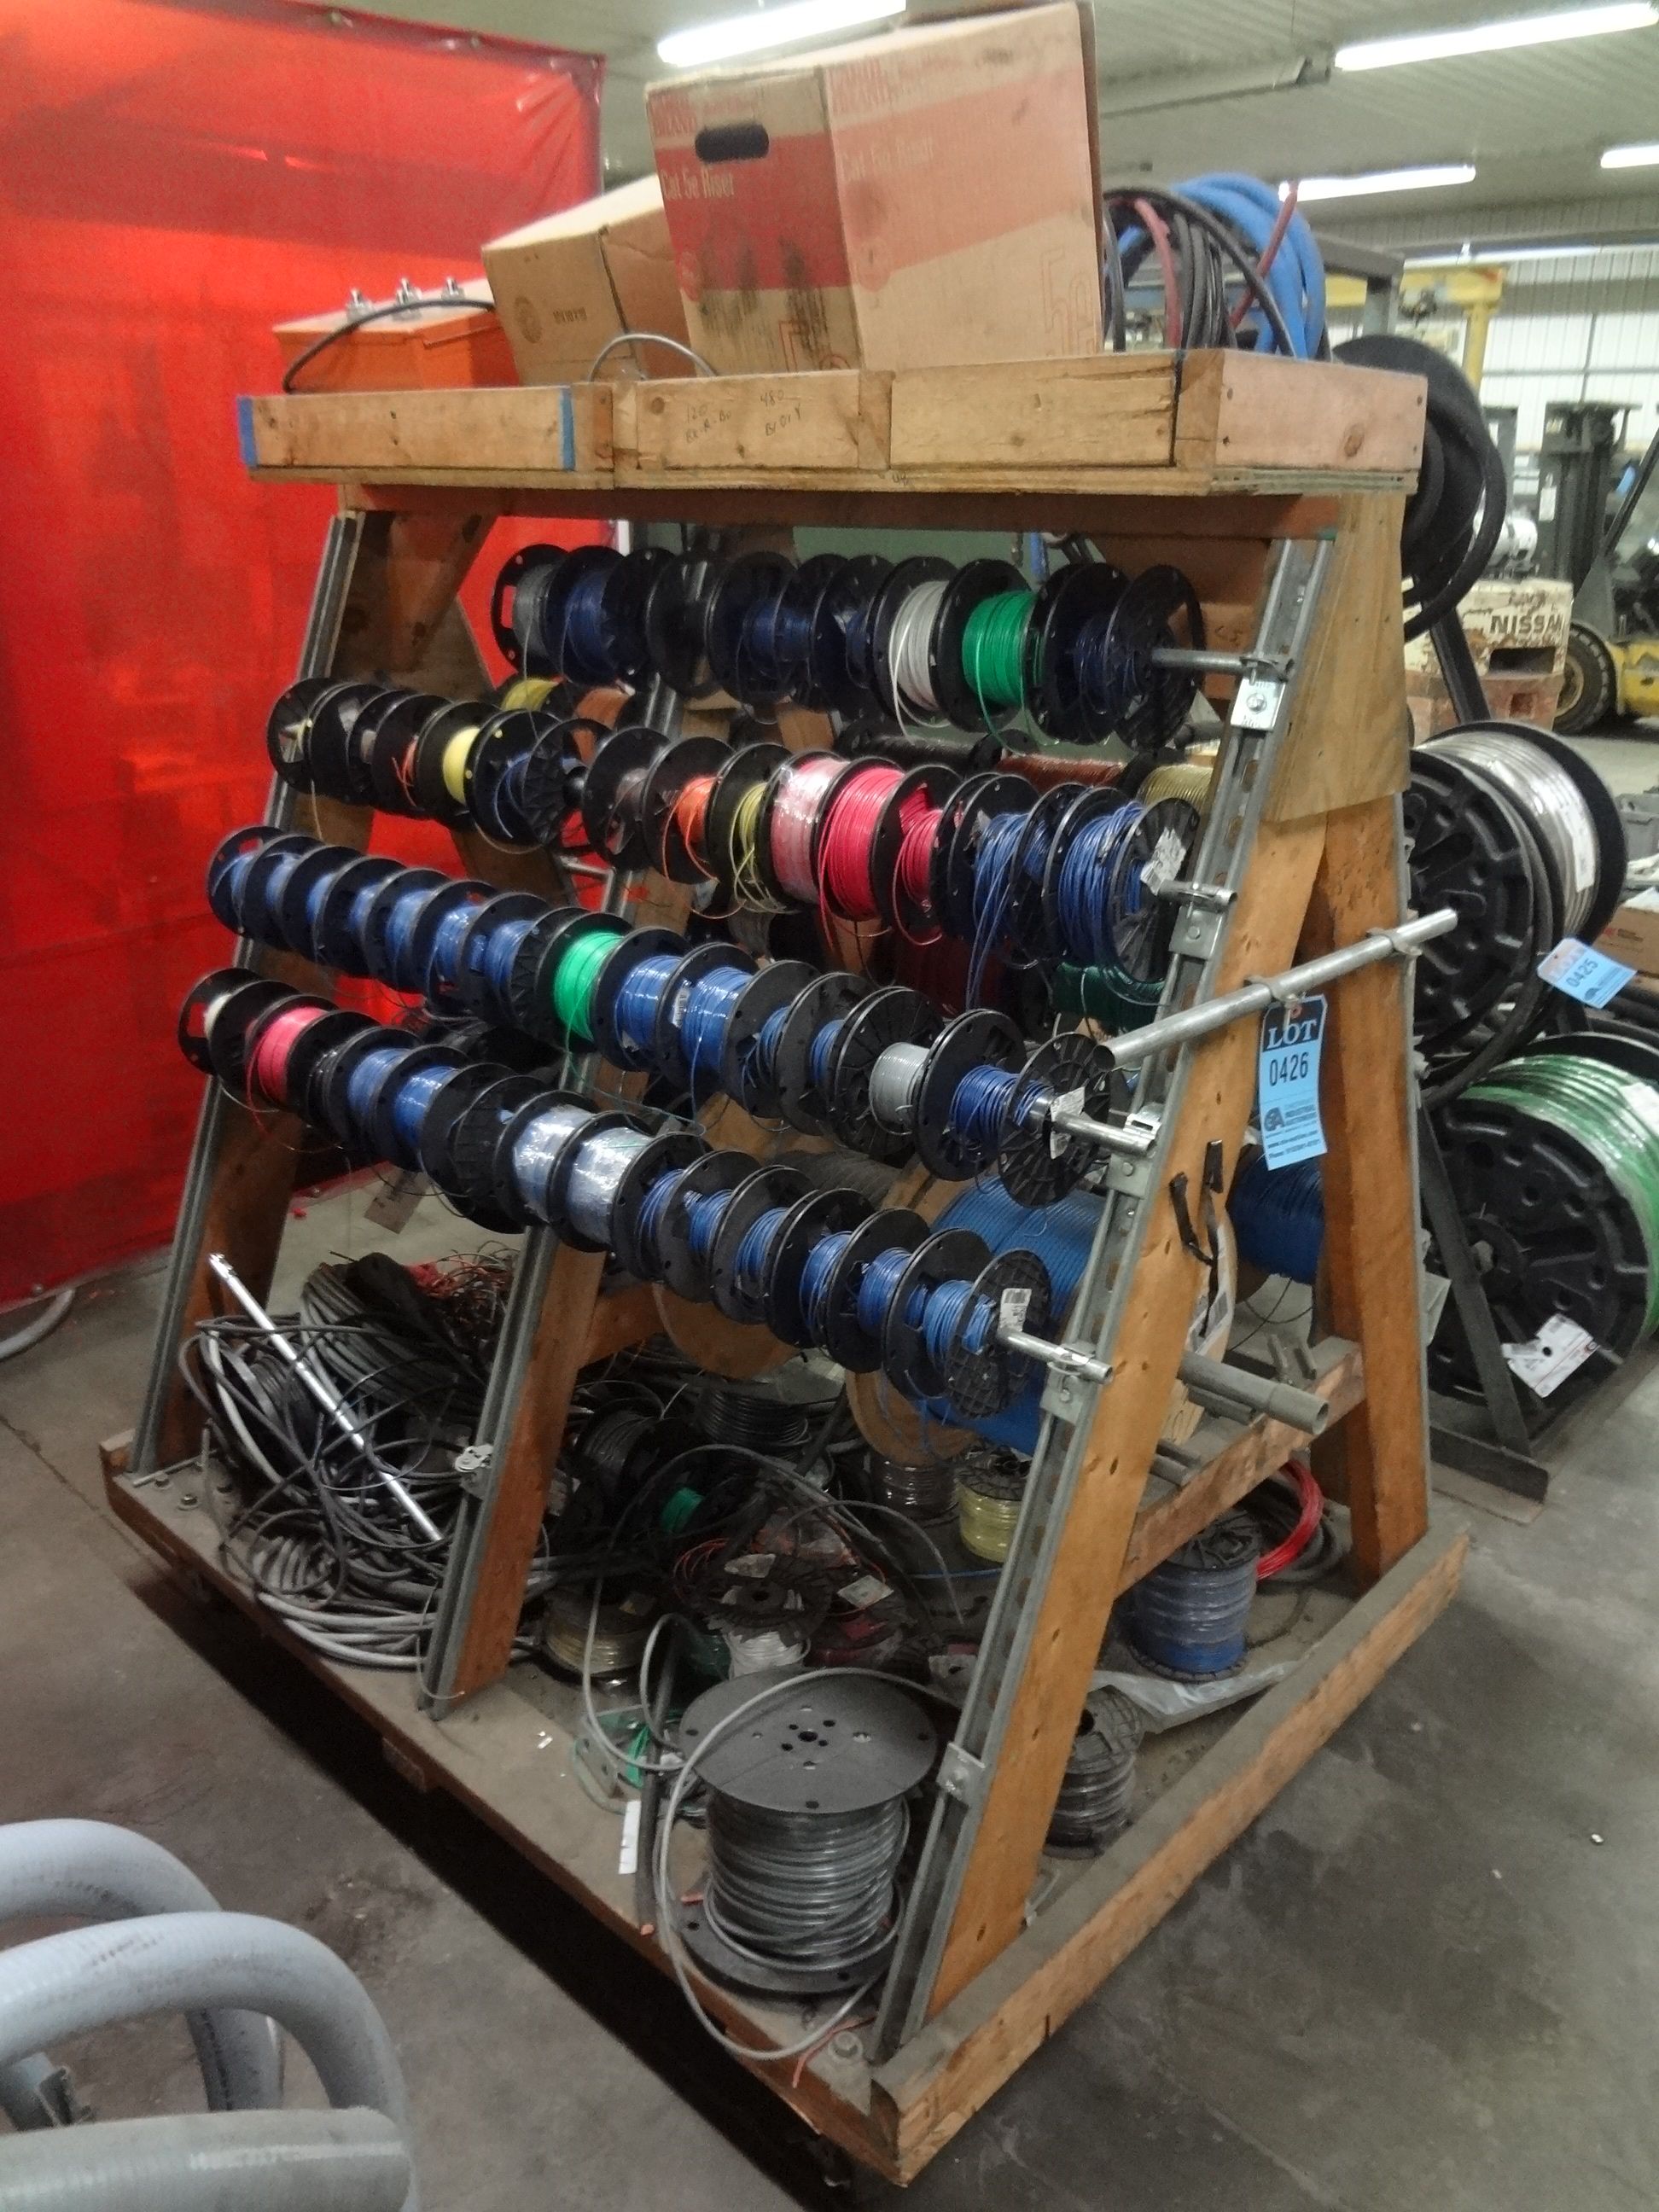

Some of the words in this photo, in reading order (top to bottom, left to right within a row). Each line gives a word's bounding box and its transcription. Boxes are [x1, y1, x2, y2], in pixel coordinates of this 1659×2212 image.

[661, 167, 682, 200] Cat
[760, 389, 784, 406] 480
[1566, 958, 1598, 987] 0425
[1266, 1019, 1318, 1050] LOT
[1269, 1051, 1309, 1086] 0426
